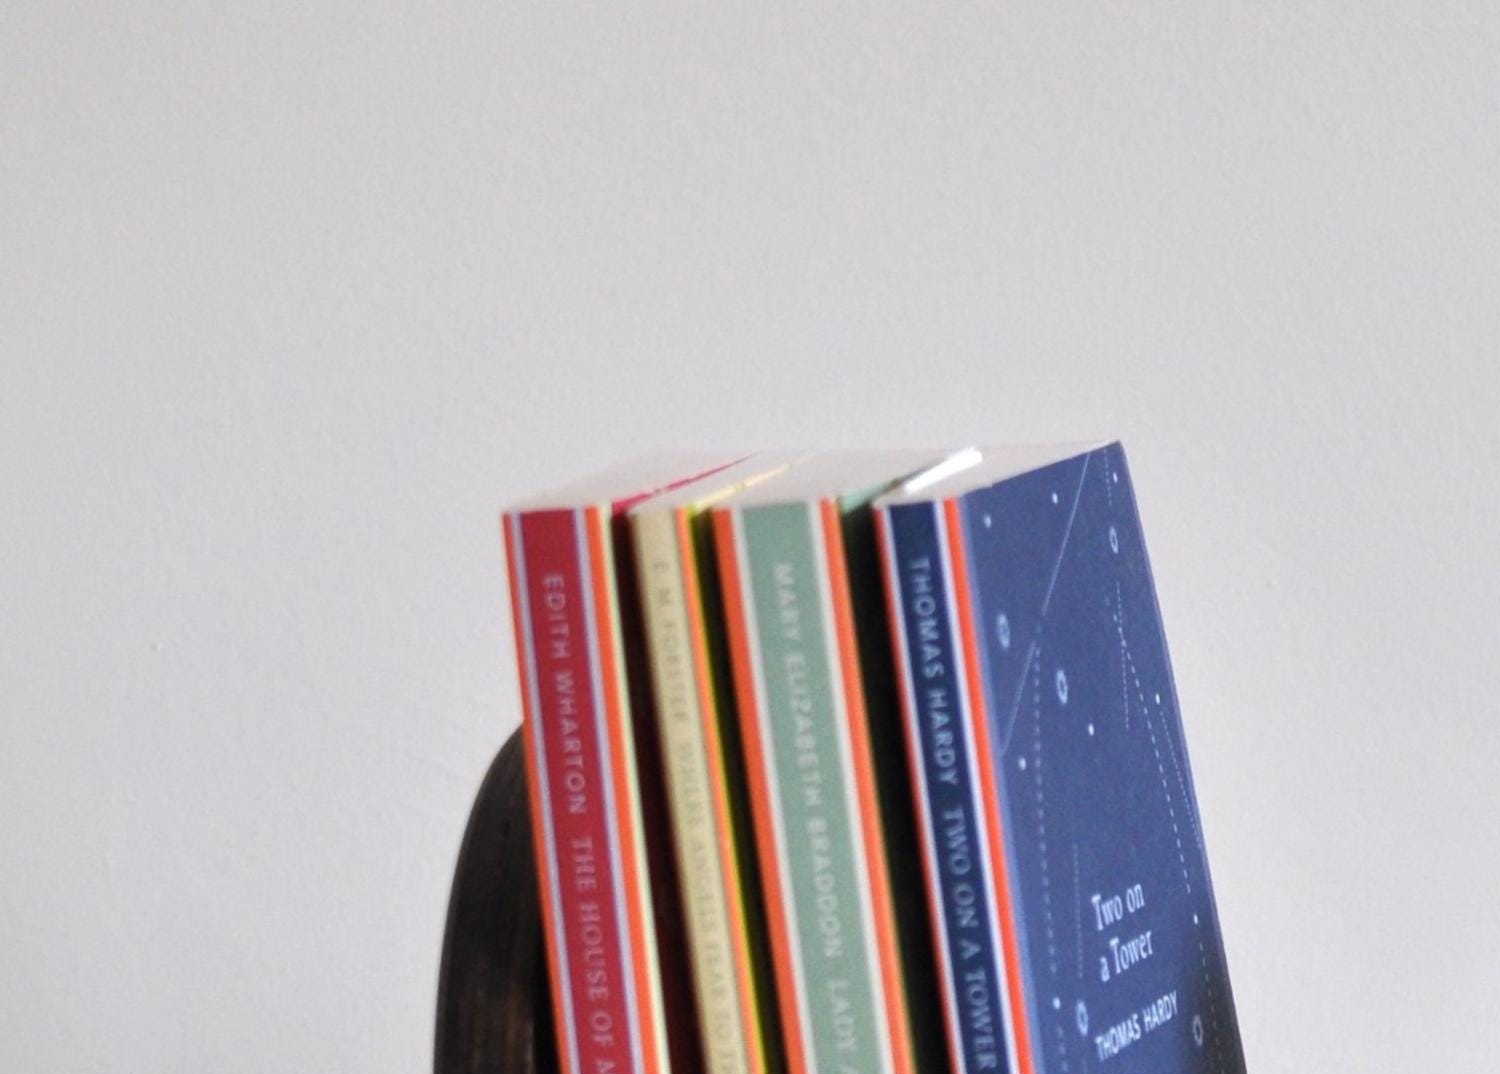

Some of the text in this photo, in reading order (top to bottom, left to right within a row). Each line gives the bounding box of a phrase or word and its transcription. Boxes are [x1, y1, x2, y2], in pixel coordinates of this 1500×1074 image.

[543, 572, 571, 659] EDITH
[773, 561, 799, 640] MARY
[556, 671, 588, 814] WHARTON
[785, 652, 822, 807] ELIZABETH
[911, 557, 997, 1071] THOMAS HARDY TWO ON A TOWER
[572, 837, 597, 892] THE
[807, 818, 843, 959] BRADDON
[1091, 883, 1146, 932] Two on
[580, 901, 609, 1000] HOUSE
[1100, 930, 1154, 983] a Tower
[590, 1009, 614, 1048] OF
[829, 979, 857, 1051] LADY
[1094, 989, 1178, 1062] THOMAS HARDY
